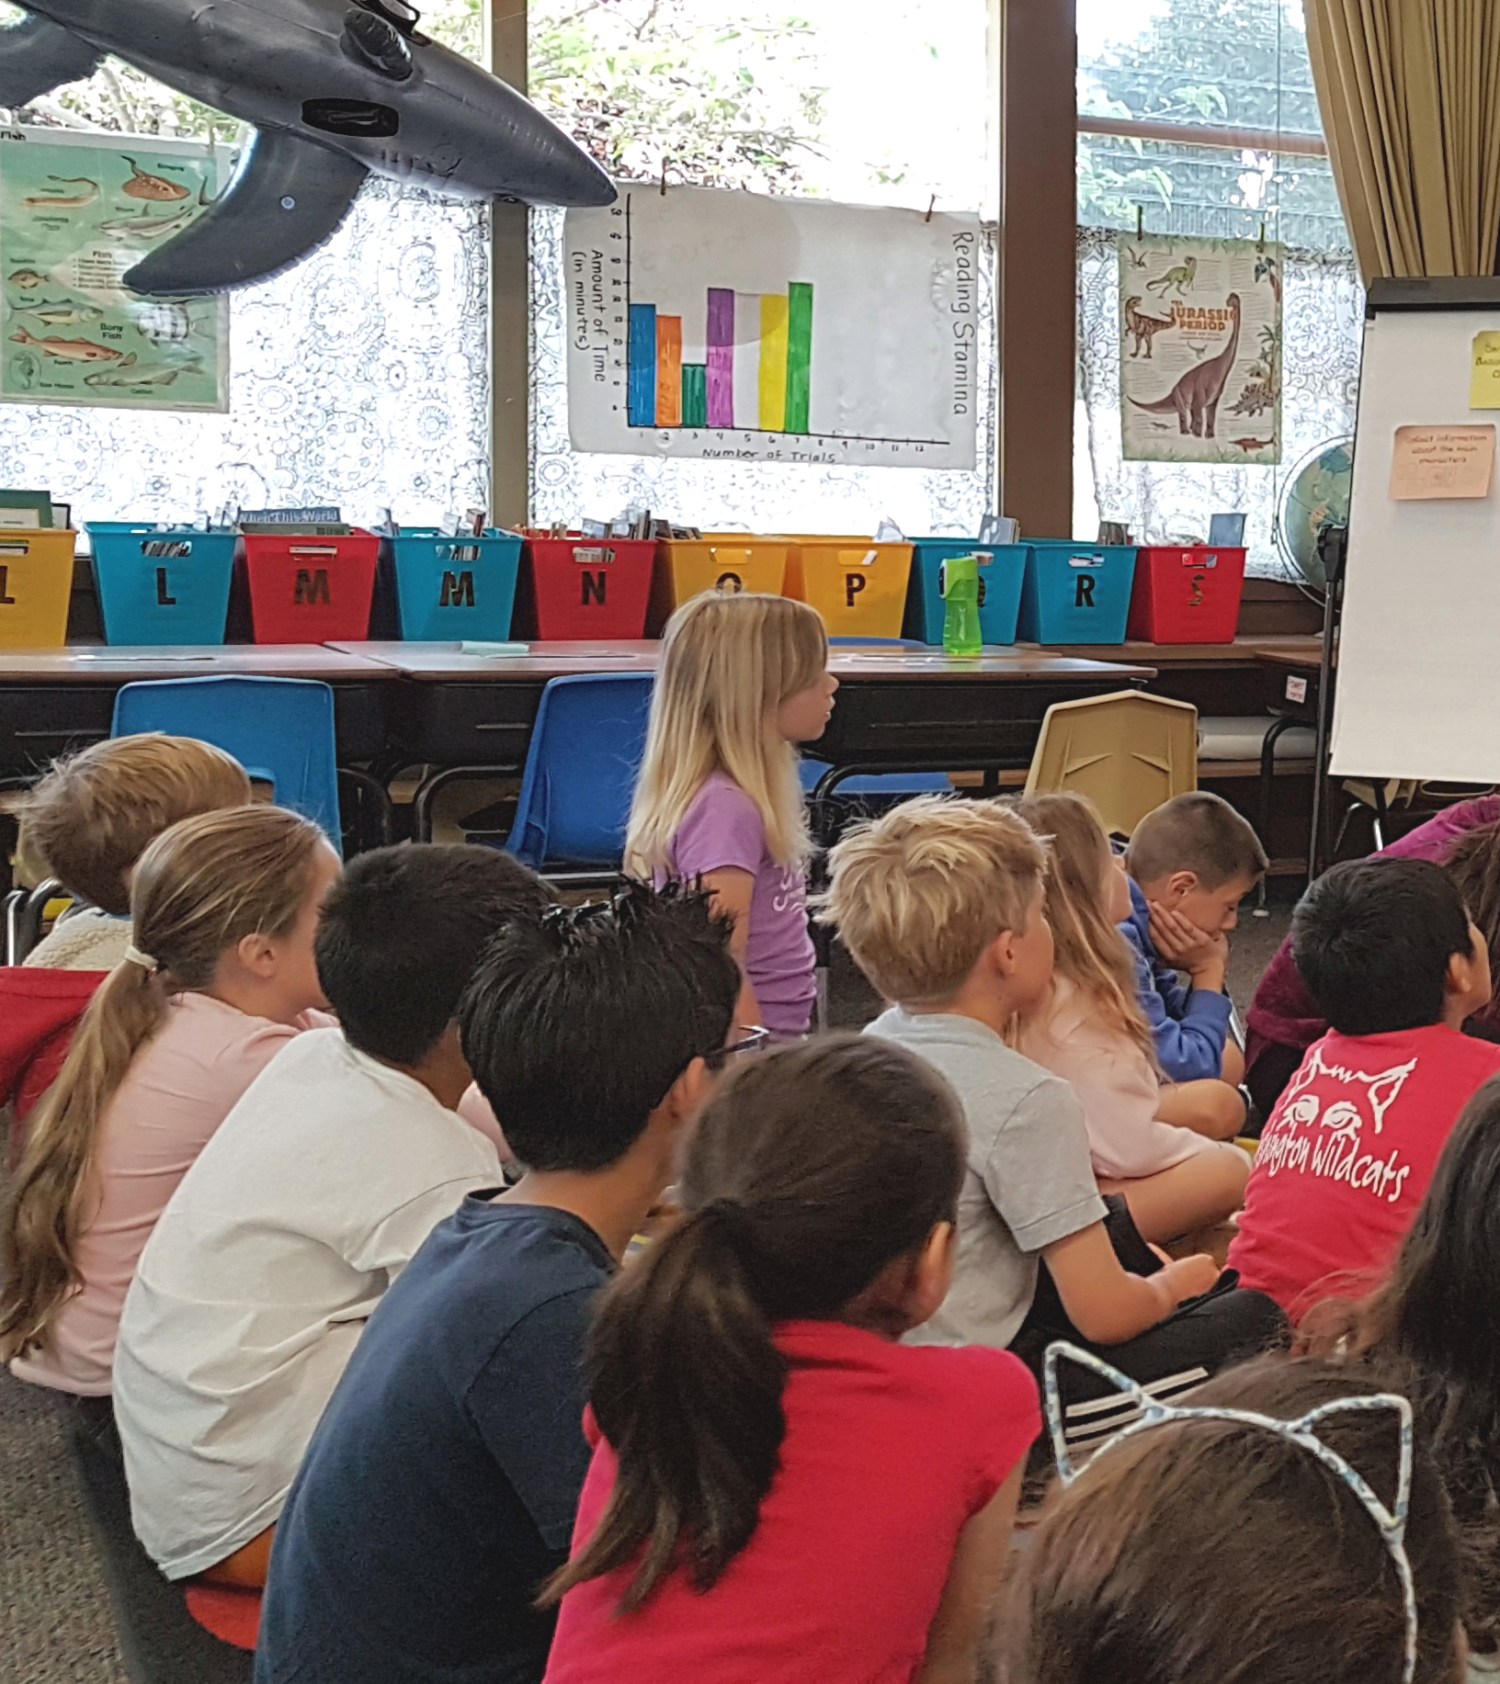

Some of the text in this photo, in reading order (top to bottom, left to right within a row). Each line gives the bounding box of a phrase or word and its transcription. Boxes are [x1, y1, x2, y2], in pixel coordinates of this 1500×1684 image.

[591, 249, 607, 313] Amount
[951, 231, 976, 416] Reading Stamina
[1179, 320, 1226, 331] PERIOD
[591, 344, 609, 382] Time
[702, 448, 836, 464] Number of Trials
[156, 567, 176, 605] L
[294, 568, 331, 605] M
[439, 571, 475, 607] M
[581, 570, 607, 606] N
[845, 573, 866, 608] P
[1074, 574, 1096, 608] R
[1187, 574, 1206, 607] S
